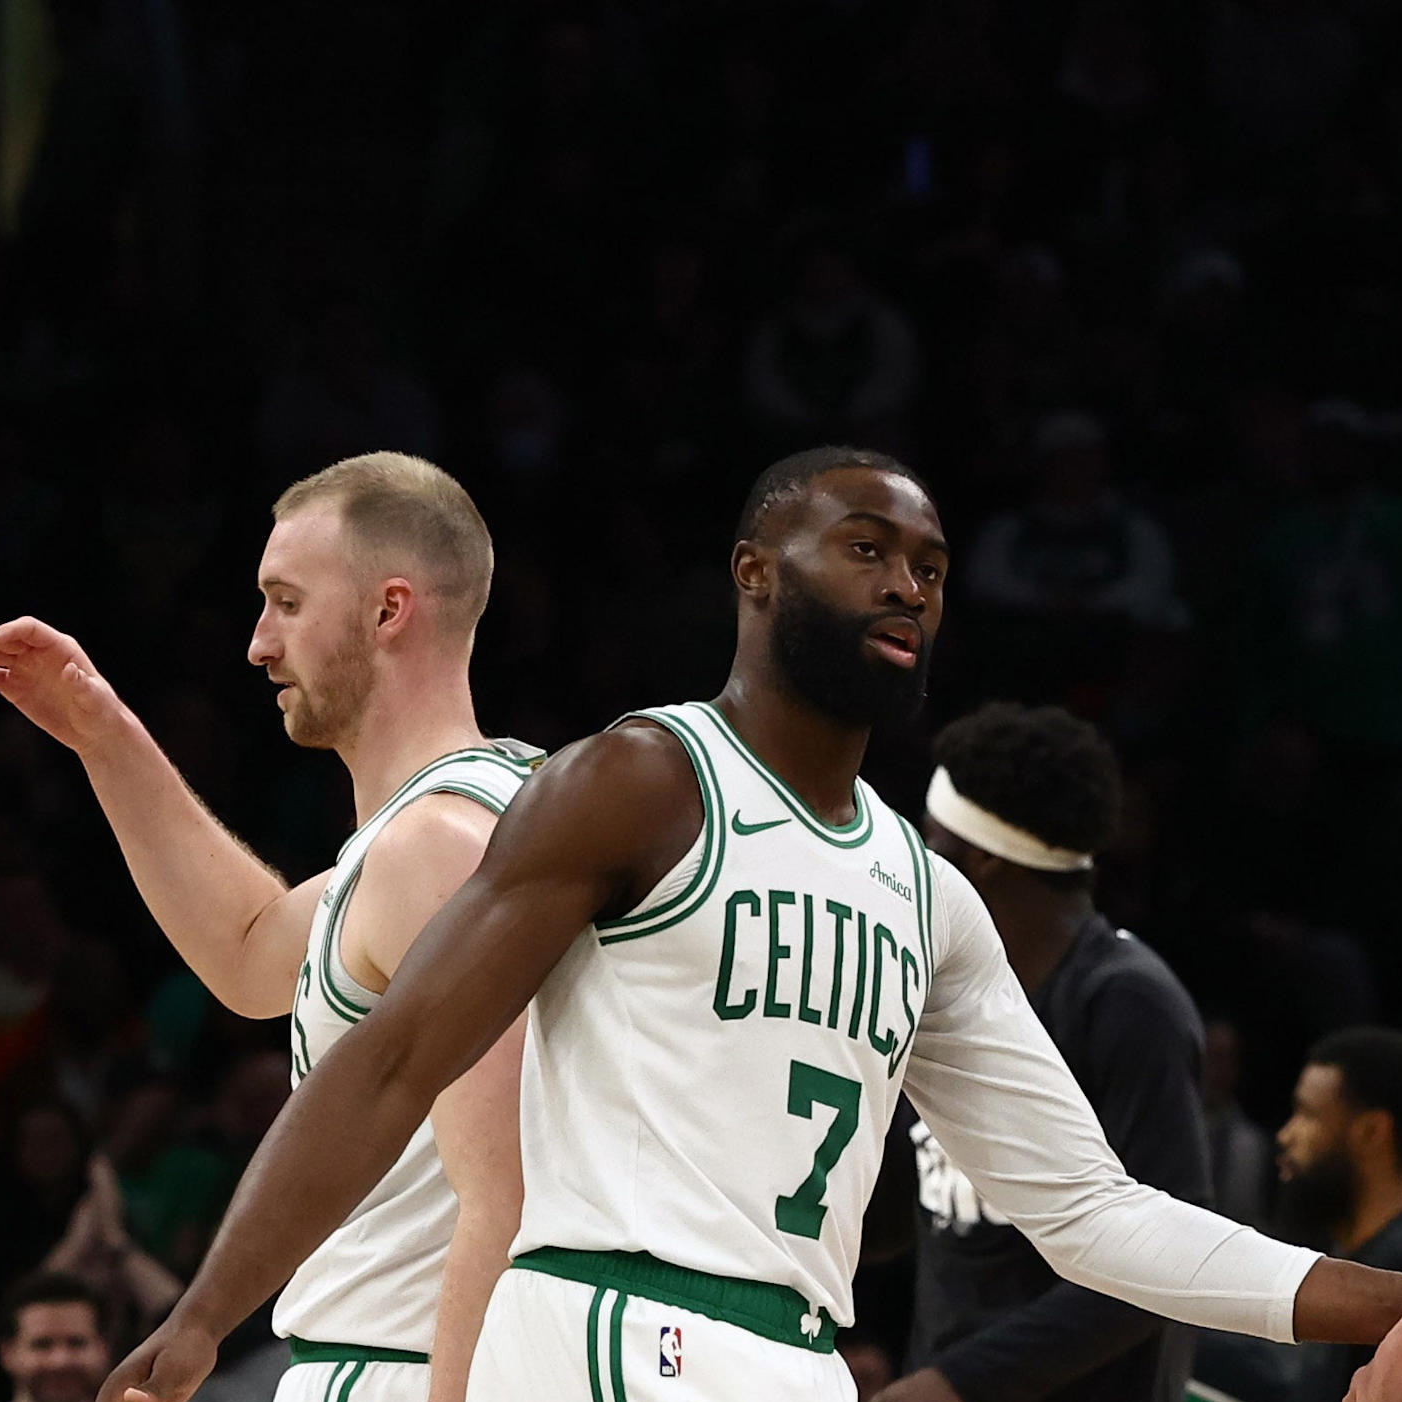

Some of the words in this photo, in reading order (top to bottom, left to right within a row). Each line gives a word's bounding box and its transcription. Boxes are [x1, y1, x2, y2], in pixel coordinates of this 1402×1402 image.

[870, 861, 911, 902] Amica
[713, 890, 919, 1079] CELTICS
[775, 1059, 862, 1240] 7
